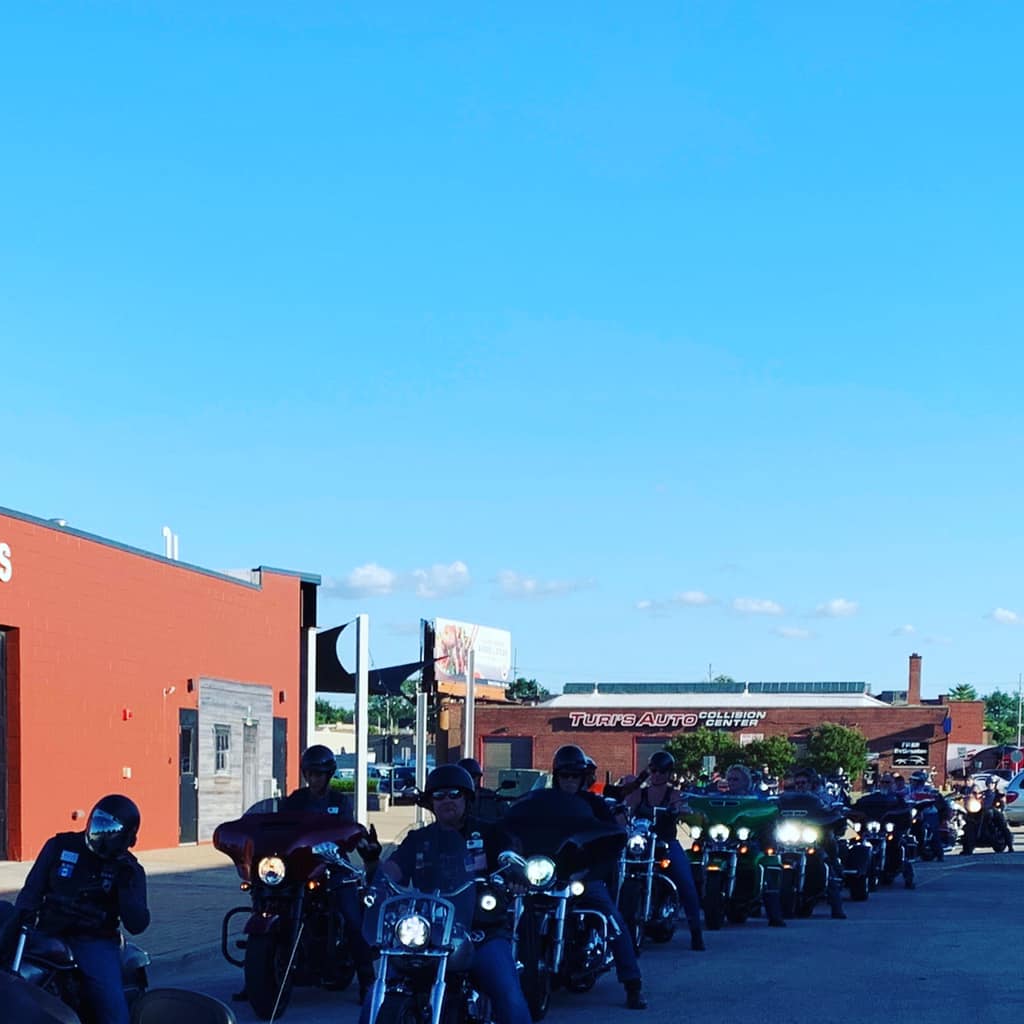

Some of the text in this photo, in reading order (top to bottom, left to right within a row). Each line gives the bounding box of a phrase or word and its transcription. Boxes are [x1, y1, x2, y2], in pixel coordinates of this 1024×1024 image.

[634, 711, 699, 728] AUTO
[698, 711, 767, 720] COLLISION
[705, 719, 759, 727] CENTER
